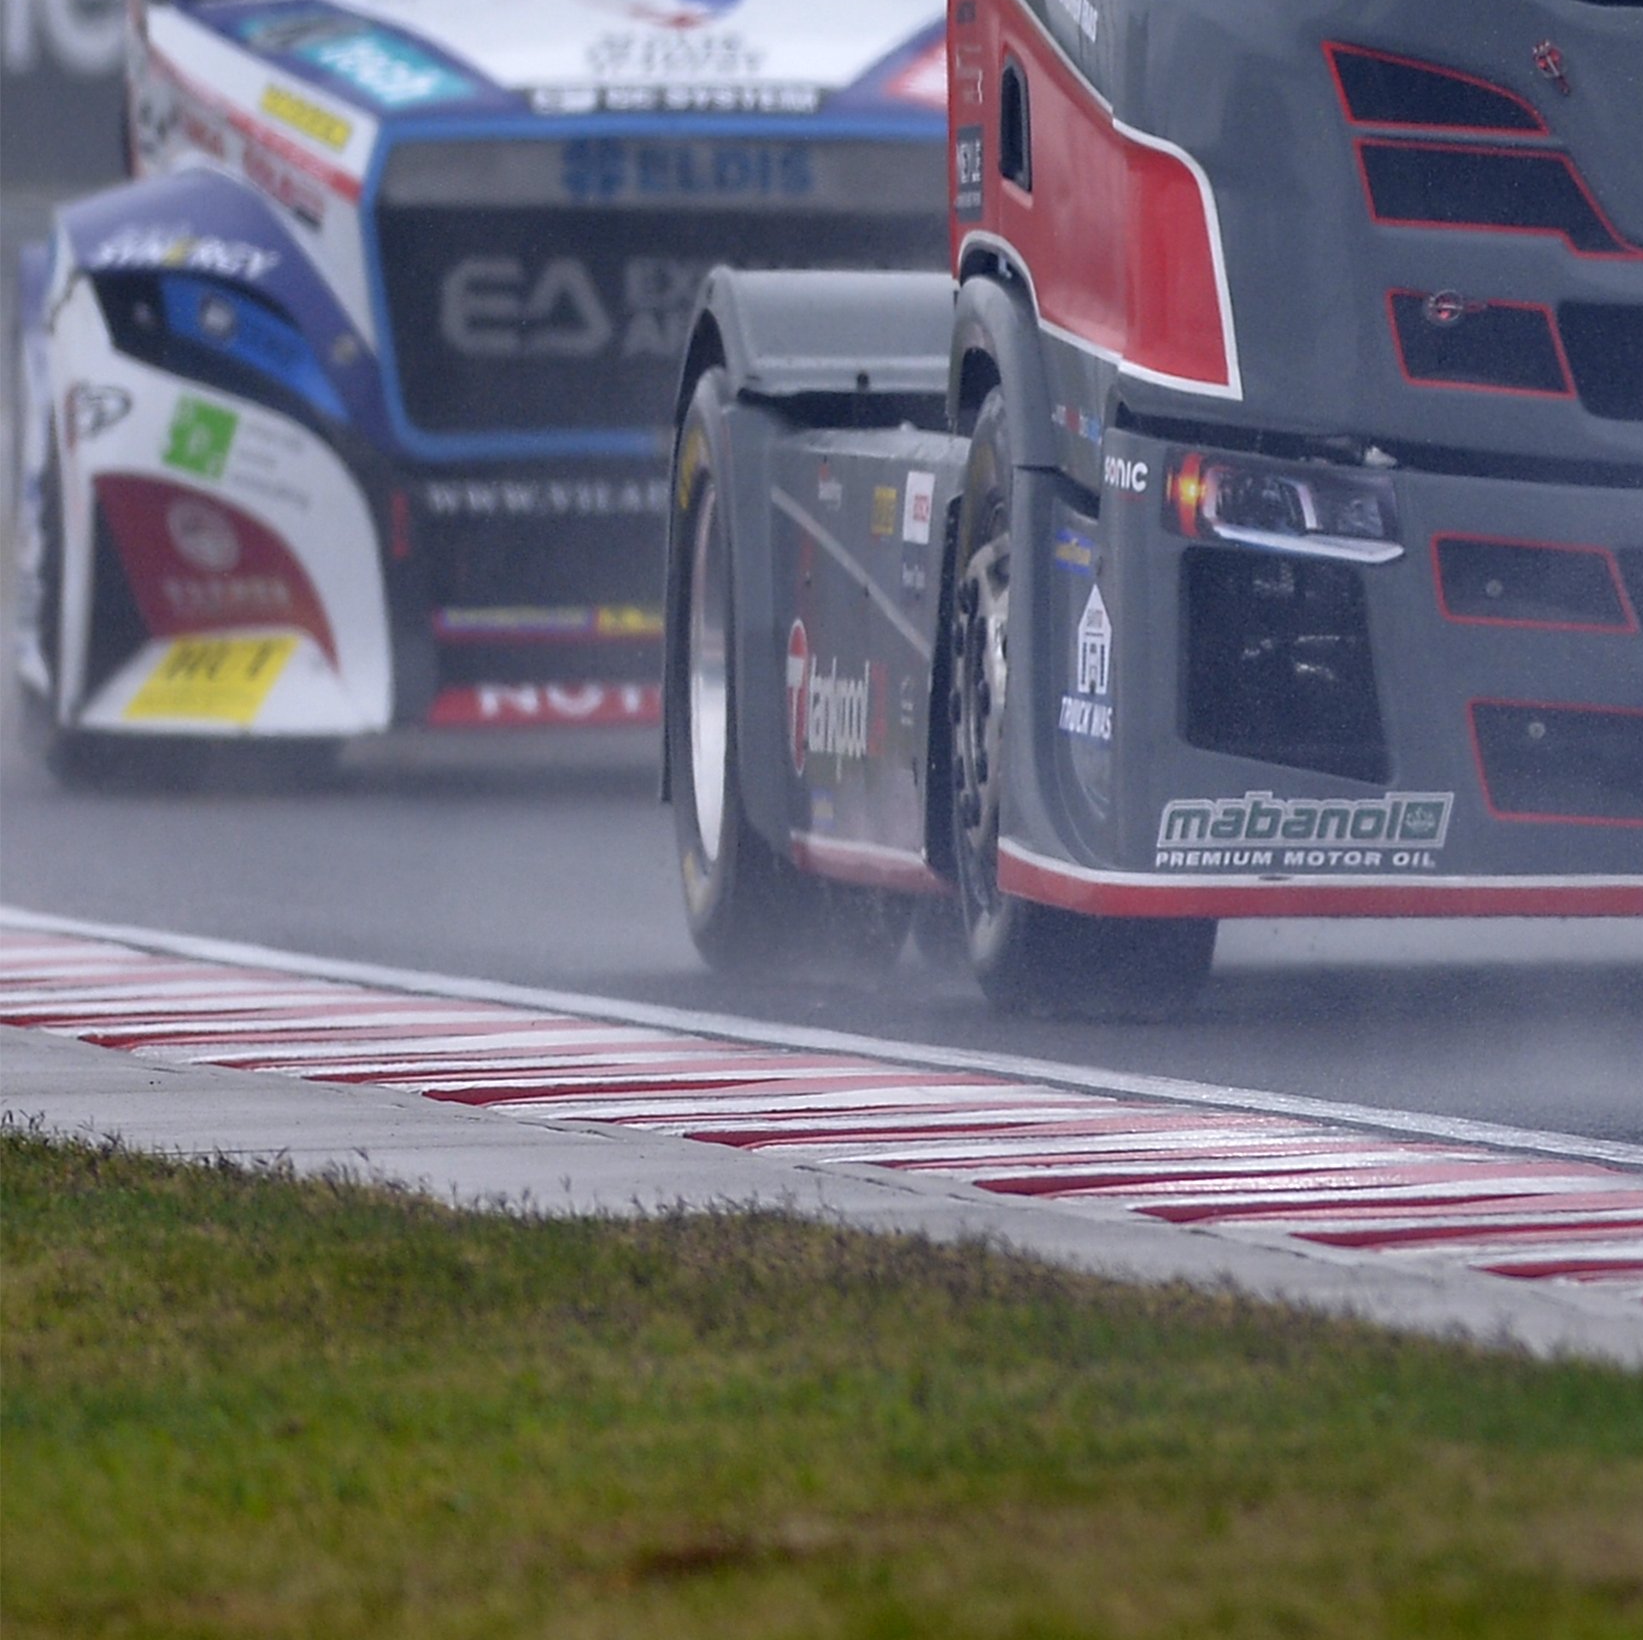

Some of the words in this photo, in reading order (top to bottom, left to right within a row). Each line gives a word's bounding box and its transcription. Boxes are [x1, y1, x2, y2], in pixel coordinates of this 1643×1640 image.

[1162, 794, 1402, 842] mabanol
[1156, 849, 1273, 868] PREMIUM
[1283, 850, 1382, 868] MOTOR
[1392, 850, 1436, 868] OIL
